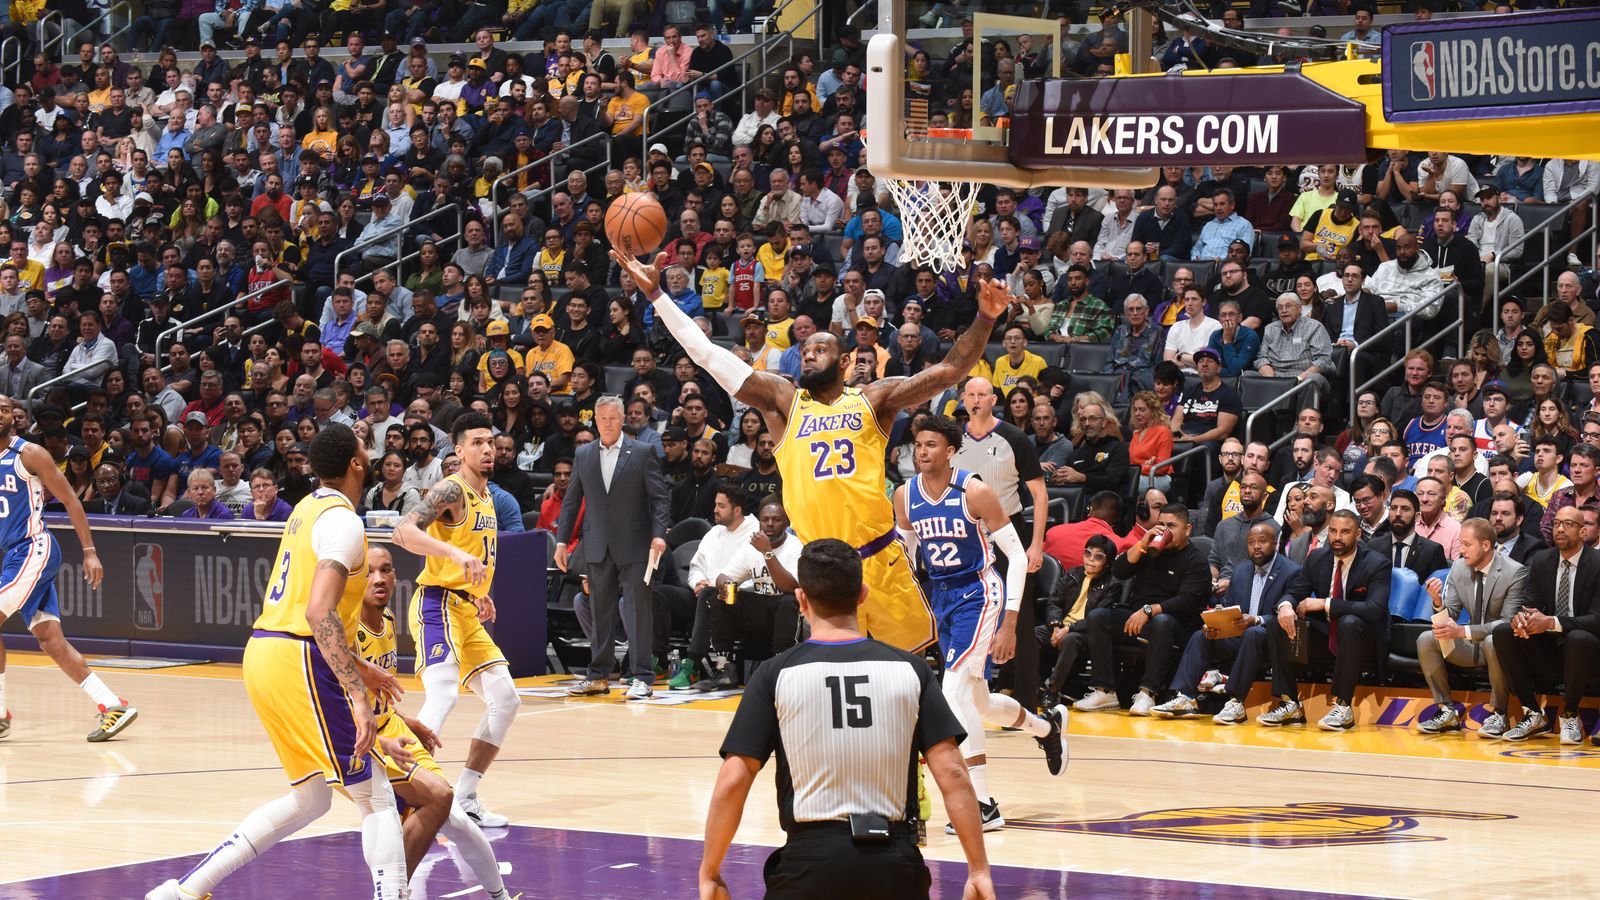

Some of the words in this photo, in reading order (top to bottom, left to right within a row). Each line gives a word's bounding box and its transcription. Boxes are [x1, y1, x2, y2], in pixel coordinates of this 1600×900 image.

[1440, 36, 1600, 98] NBAStore.c
[1044, 114, 1279, 154] LAKERS.COM
[1315, 226, 1348, 244] LAKERS
[703, 283, 715, 295] 23
[739, 283, 750, 291] 25
[795, 412, 863, 439] LAKERS
[810, 439, 857, 480] 23
[912, 517, 968, 539] PHILA
[927, 541, 962, 567] 22
[271, 551, 291, 600] 3
[825, 675, 873, 729] 15
